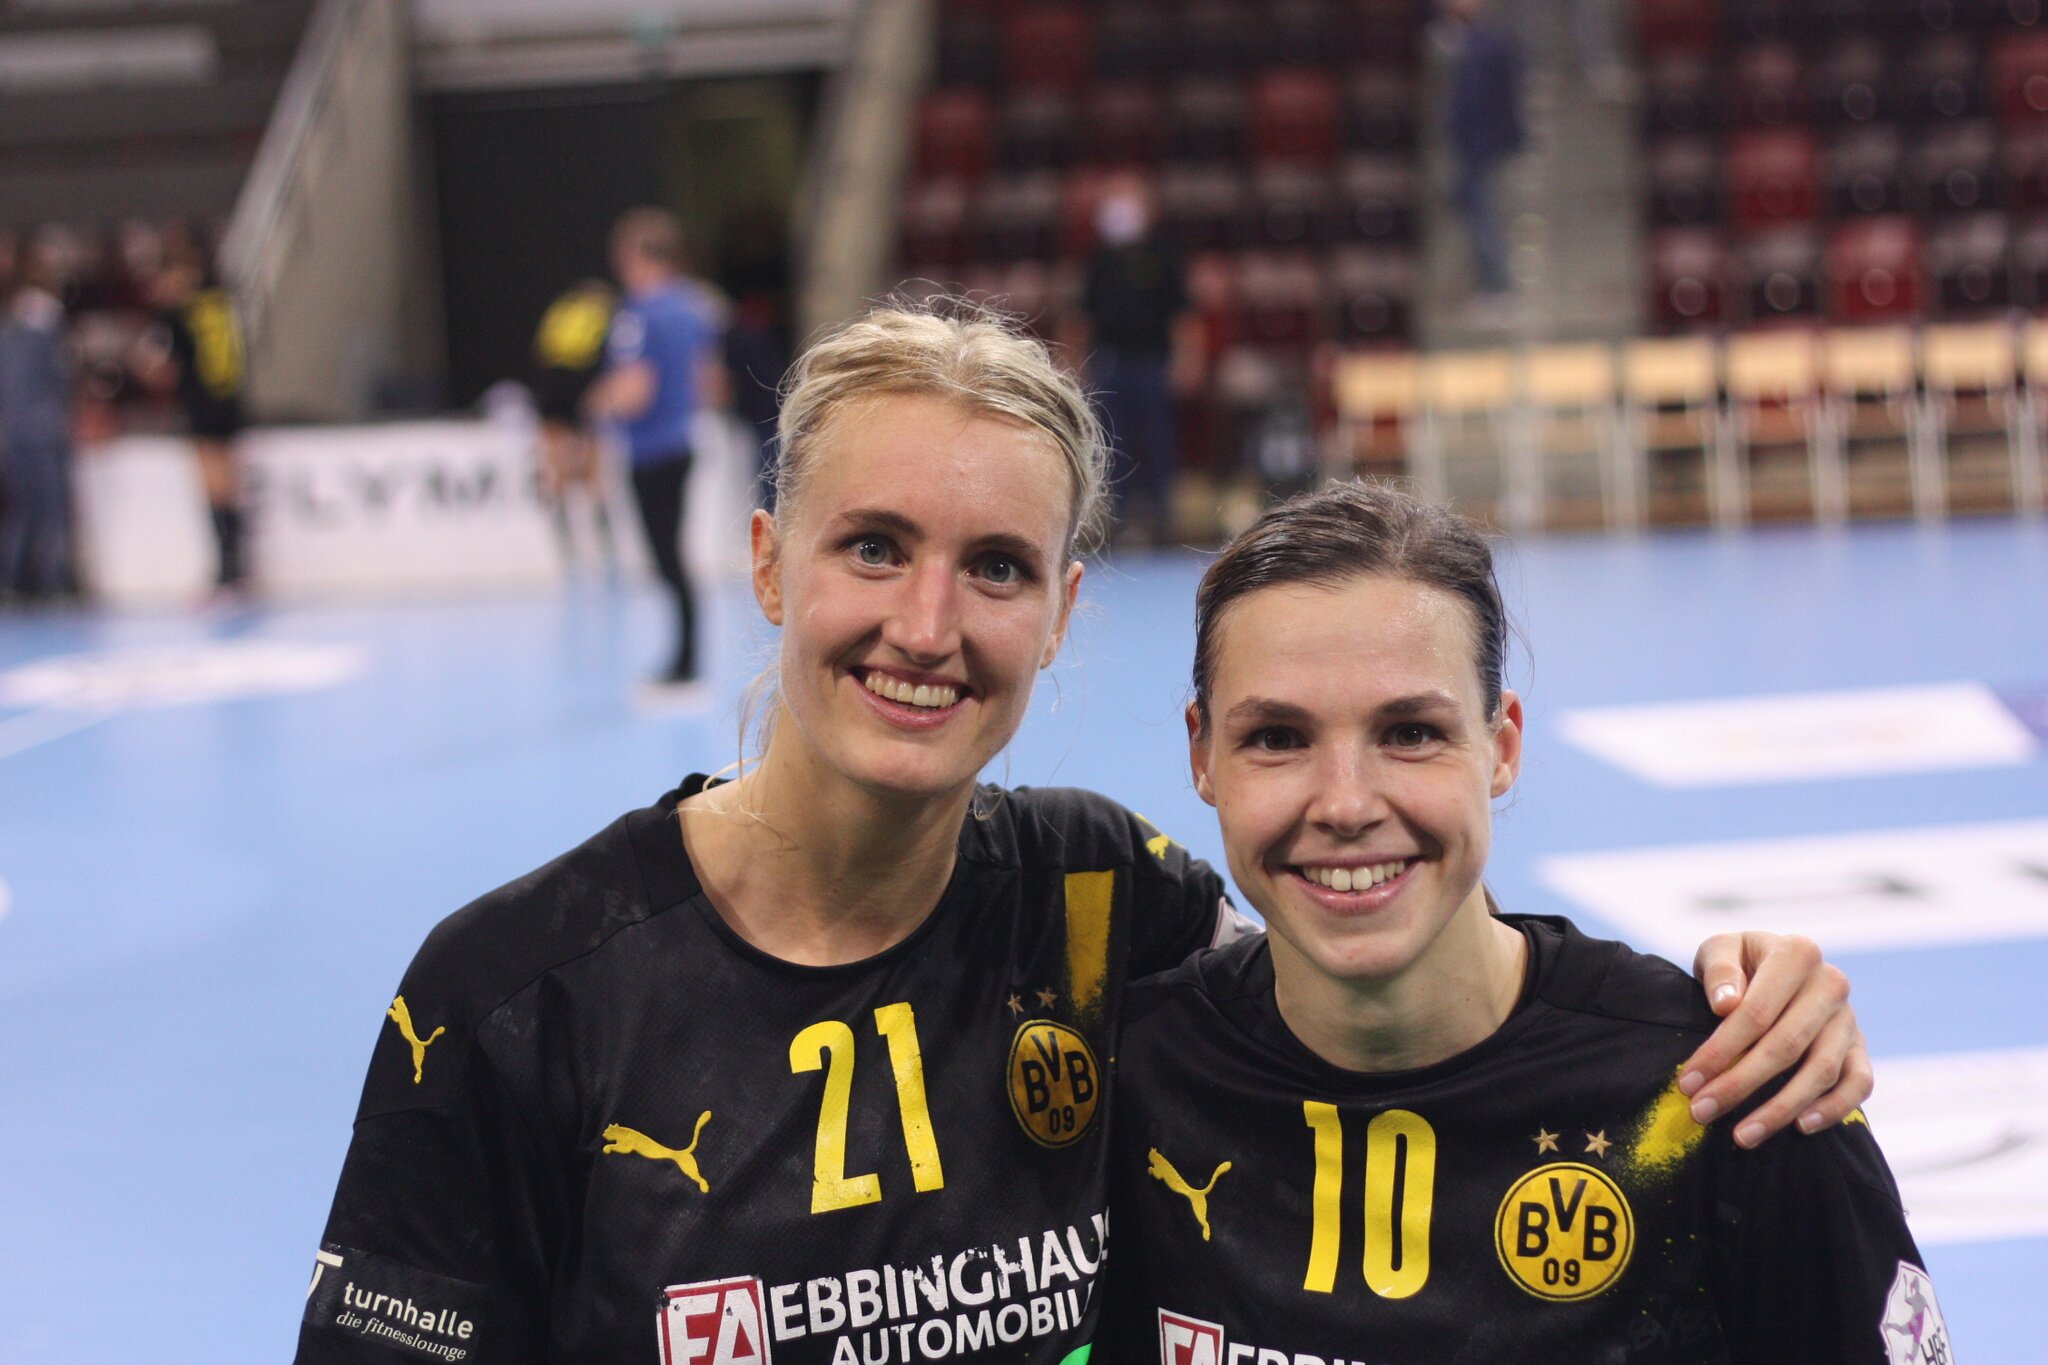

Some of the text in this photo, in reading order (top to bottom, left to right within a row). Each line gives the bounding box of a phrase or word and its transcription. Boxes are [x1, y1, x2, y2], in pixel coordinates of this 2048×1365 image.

[788, 1001, 945, 1215] 21
[1021, 1030, 1095, 1114] BVB
[1049, 1105, 1076, 1136] 09
[1303, 1099, 1437, 1300] 10
[1516, 1176, 1618, 1262] BVB
[343, 1281, 474, 1340] turnhalle
[1541, 1257, 1581, 1286] 09
[335, 1310, 467, 1362] die fitnesslounge
[832, 1278, 1096, 1365] AUTOMOBIL
